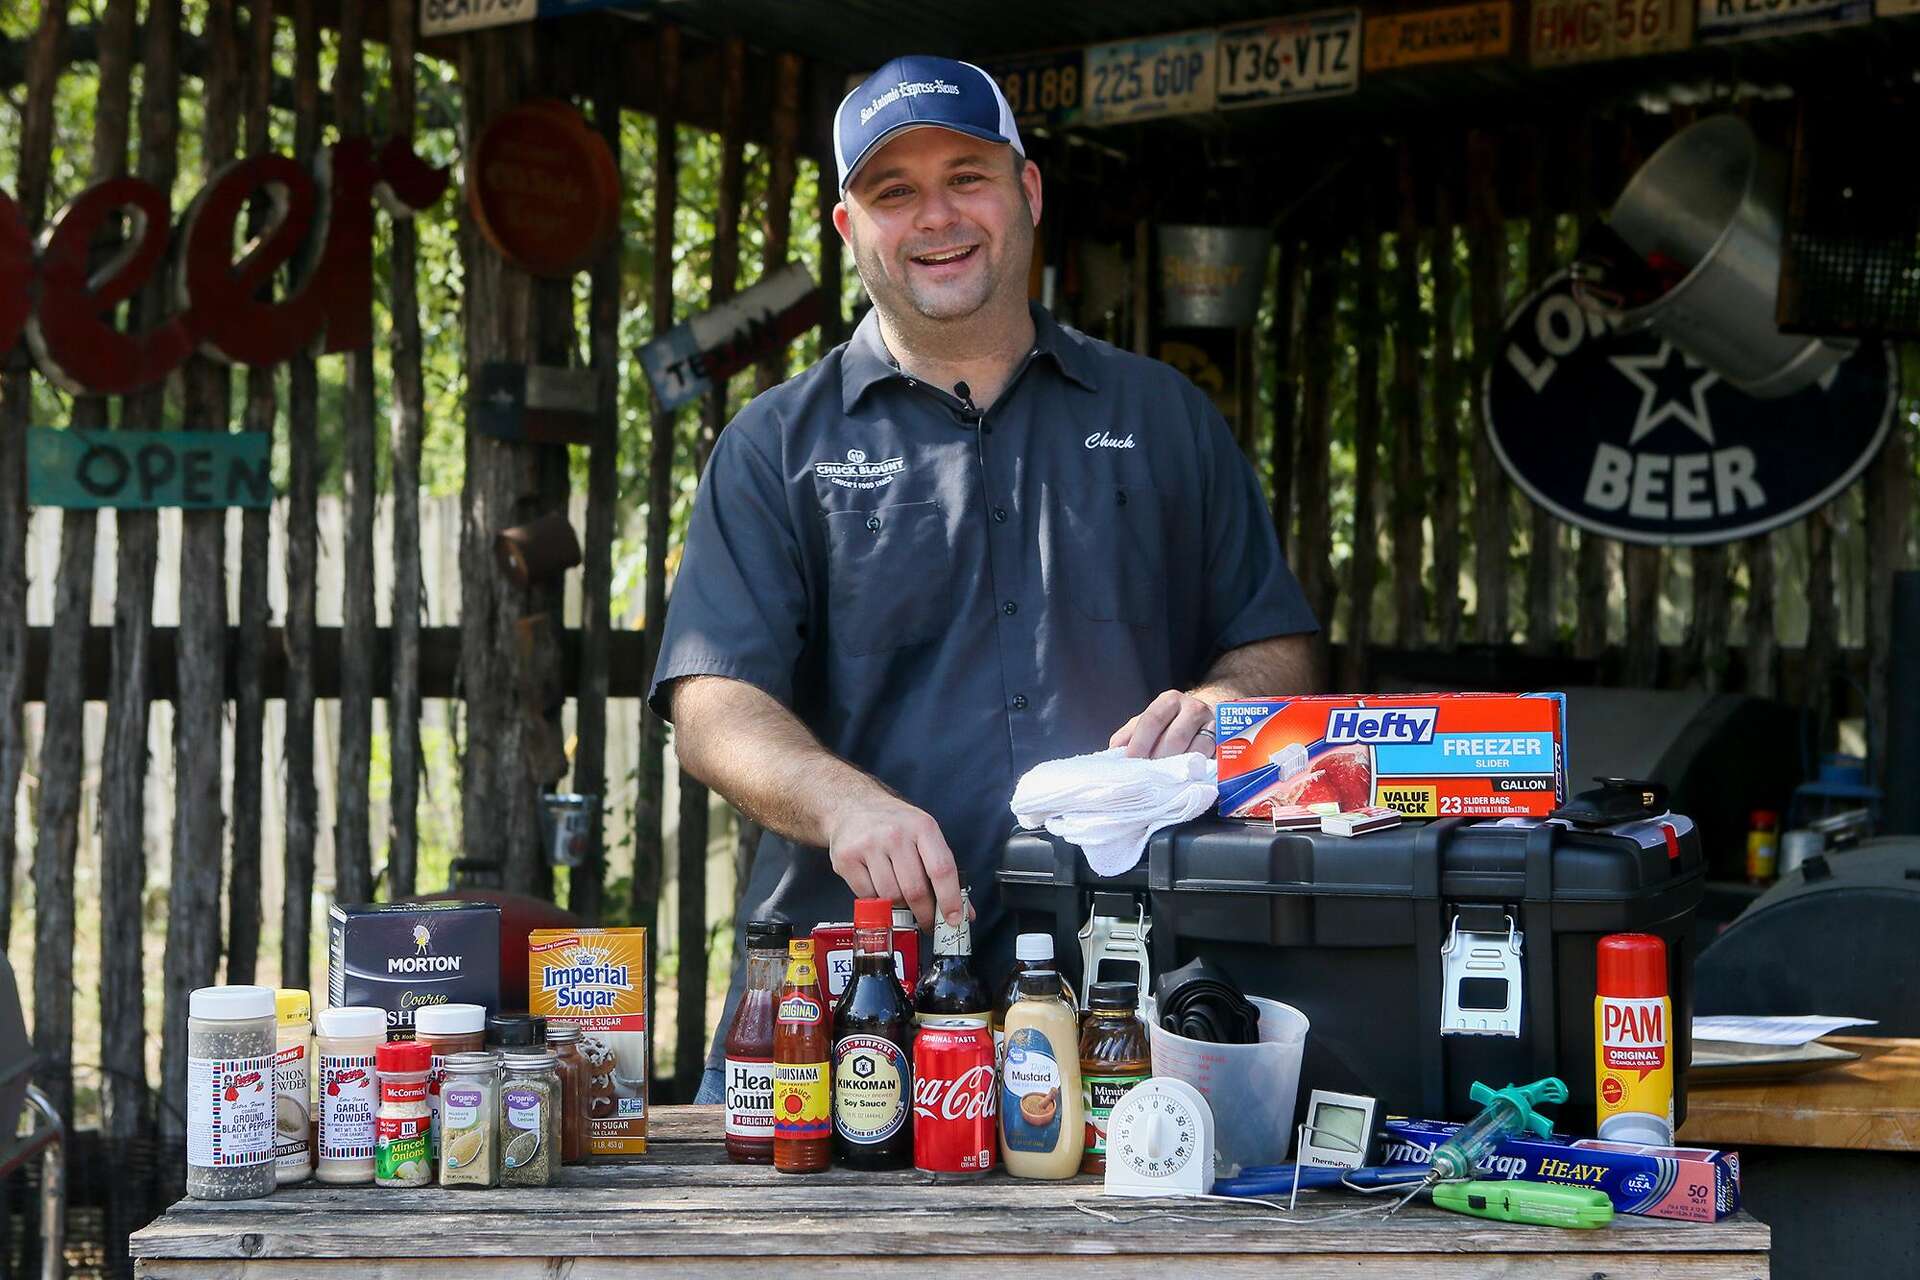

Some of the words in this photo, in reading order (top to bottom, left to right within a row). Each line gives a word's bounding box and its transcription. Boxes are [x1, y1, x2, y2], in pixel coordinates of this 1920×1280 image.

[0, 137, 450, 396] eer
[1085, 431, 1136, 450] Chuck
[75, 441, 271, 504] OPEN
[816, 463, 857, 476] CHUCK
[858, 459, 904, 475] BLOUNT
[1583, 442, 1768, 521] BEER
[1220, 706, 1269, 717] STRONGER
[1220, 716, 1244, 726] SEAL
[1331, 710, 1432, 741] Hefty
[1443, 737, 1542, 757] FREEZER
[1475, 759, 1510, 768] SLIDER
[1500, 780, 1547, 791] GALLON
[1383, 791, 1430, 803] VALUE
[1463, 796, 1490, 806] SLIDER
[1491, 796, 1510, 806] BAGS
[1387, 802, 1428, 814] PACK
[1440, 796, 1462, 814] 23
[388, 957, 460, 975] MORTON
[544, 962, 627, 989] Imperial
[400, 990, 449, 1009] Coarse
[558, 987, 616, 1010] Sugar
[780, 1005, 816, 1018] ORIGINAL
[595, 1017, 622, 1026] SUGAR
[1604, 1004, 1662, 1043] PAM
[953, 1035, 977, 1044] TASTE
[1609, 1050, 1658, 1060] ORIGINAL
[276, 1069, 304, 1081] NION
[775, 1067, 818, 1080] LOUISIANA
[1011, 1070, 1051, 1082] Mustard
[276, 1078, 307, 1091] WDER
[837, 1078, 896, 1090] KIKKOMAN
[1094, 1085, 1130, 1096] Minute
[450, 1094, 478, 1104] Organic
[507, 1094, 535, 1104] Organic
[727, 1086, 774, 1111] Count
[844, 1098, 858, 1108] Soy
[859, 1098, 887, 1108] Sauce
[1099, 1095, 1119, 1105] Mai
[1152, 1100, 1159, 1109] 0
[336, 1102, 370, 1113] GARLIC
[1164, 1103, 1177, 1115] 55
[233, 1112, 264, 1124] GROUND
[333, 1112, 372, 1123] POWDER
[742, 1117, 774, 1126] ORIGINA
[1125, 1113, 1135, 1125] 10
[1176, 1114, 1186, 1127] 50
[222, 1123, 247, 1133] BLACK
[248, 1119, 272, 1131] PEPPER
[602, 1120, 629, 1130] SUGAR
[1121, 1128, 1130, 1140] 15
[391, 1137, 426, 1154] Minced
[1123, 1143, 1134, 1156] 20
[391, 1147, 425, 1162] Onions
[1174, 1147, 1185, 1160] 40
[1384, 1141, 1436, 1166] ynol
[1132, 1154, 1145, 1167] 25
[1147, 1161, 1160, 1172] 30
[1311, 1156, 1352, 1169] ThermoPro
[1537, 1157, 1609, 1182] HEAVY
[1628, 1179, 1652, 1190] U.S.A.
[1687, 1184, 1708, 1198] 50
